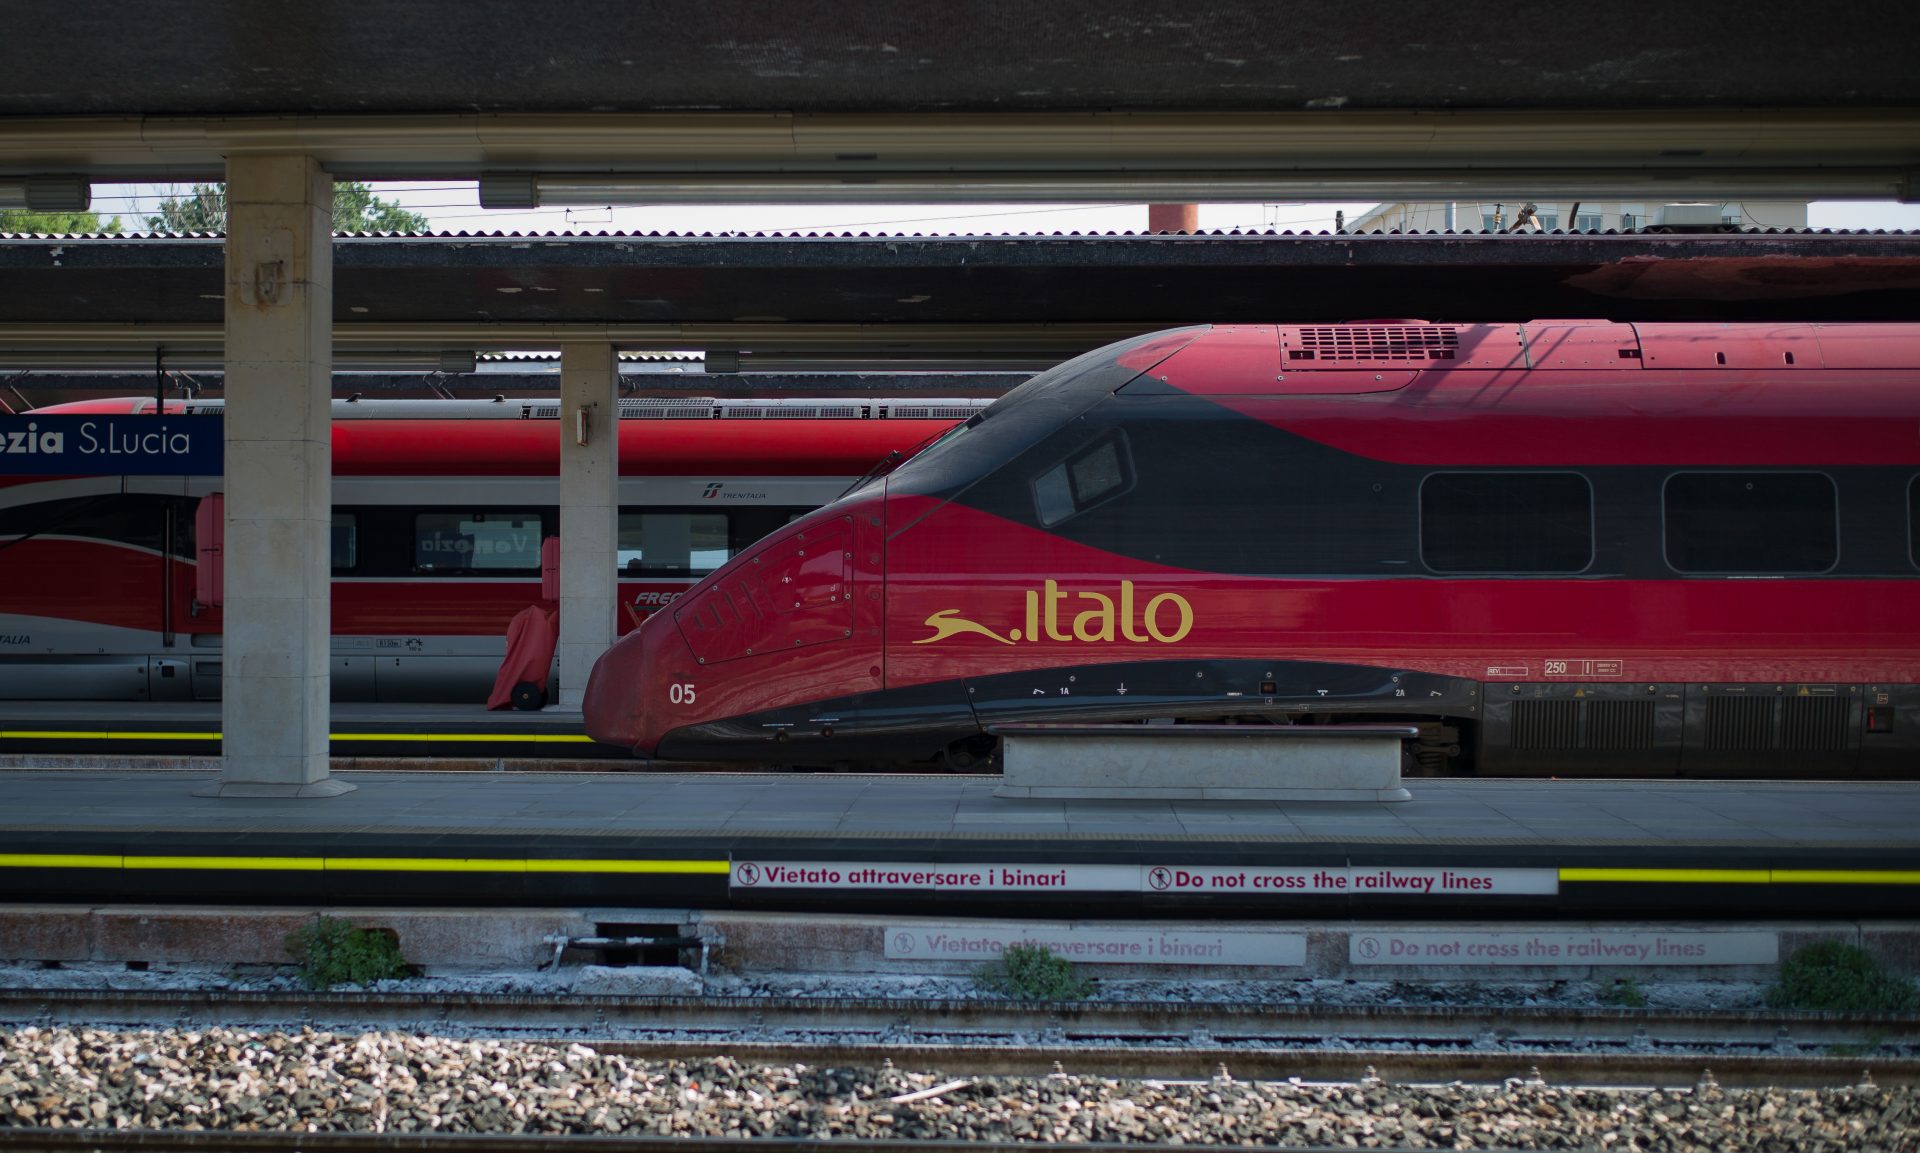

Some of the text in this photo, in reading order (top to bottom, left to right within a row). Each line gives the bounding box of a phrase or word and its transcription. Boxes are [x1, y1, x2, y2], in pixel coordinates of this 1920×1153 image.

[0, 422, 190, 454] zia S.Lucia
[1546, 662, 1567, 674] 250
[670, 684, 696, 704] 05
[1060, 687, 1069, 695] 1A
[1395, 689, 1405, 697] 2A
[765, 866, 1066, 886] Vietato attraversare i binari
[1176, 871, 1493, 893] Do not cross the railway lines
[926, 935, 1002, 953] Vietato
[1148, 938, 1153, 955] i
[1160, 937, 1222, 957] binari
[1390, 938, 1705, 961] Do not cross the railway lines
